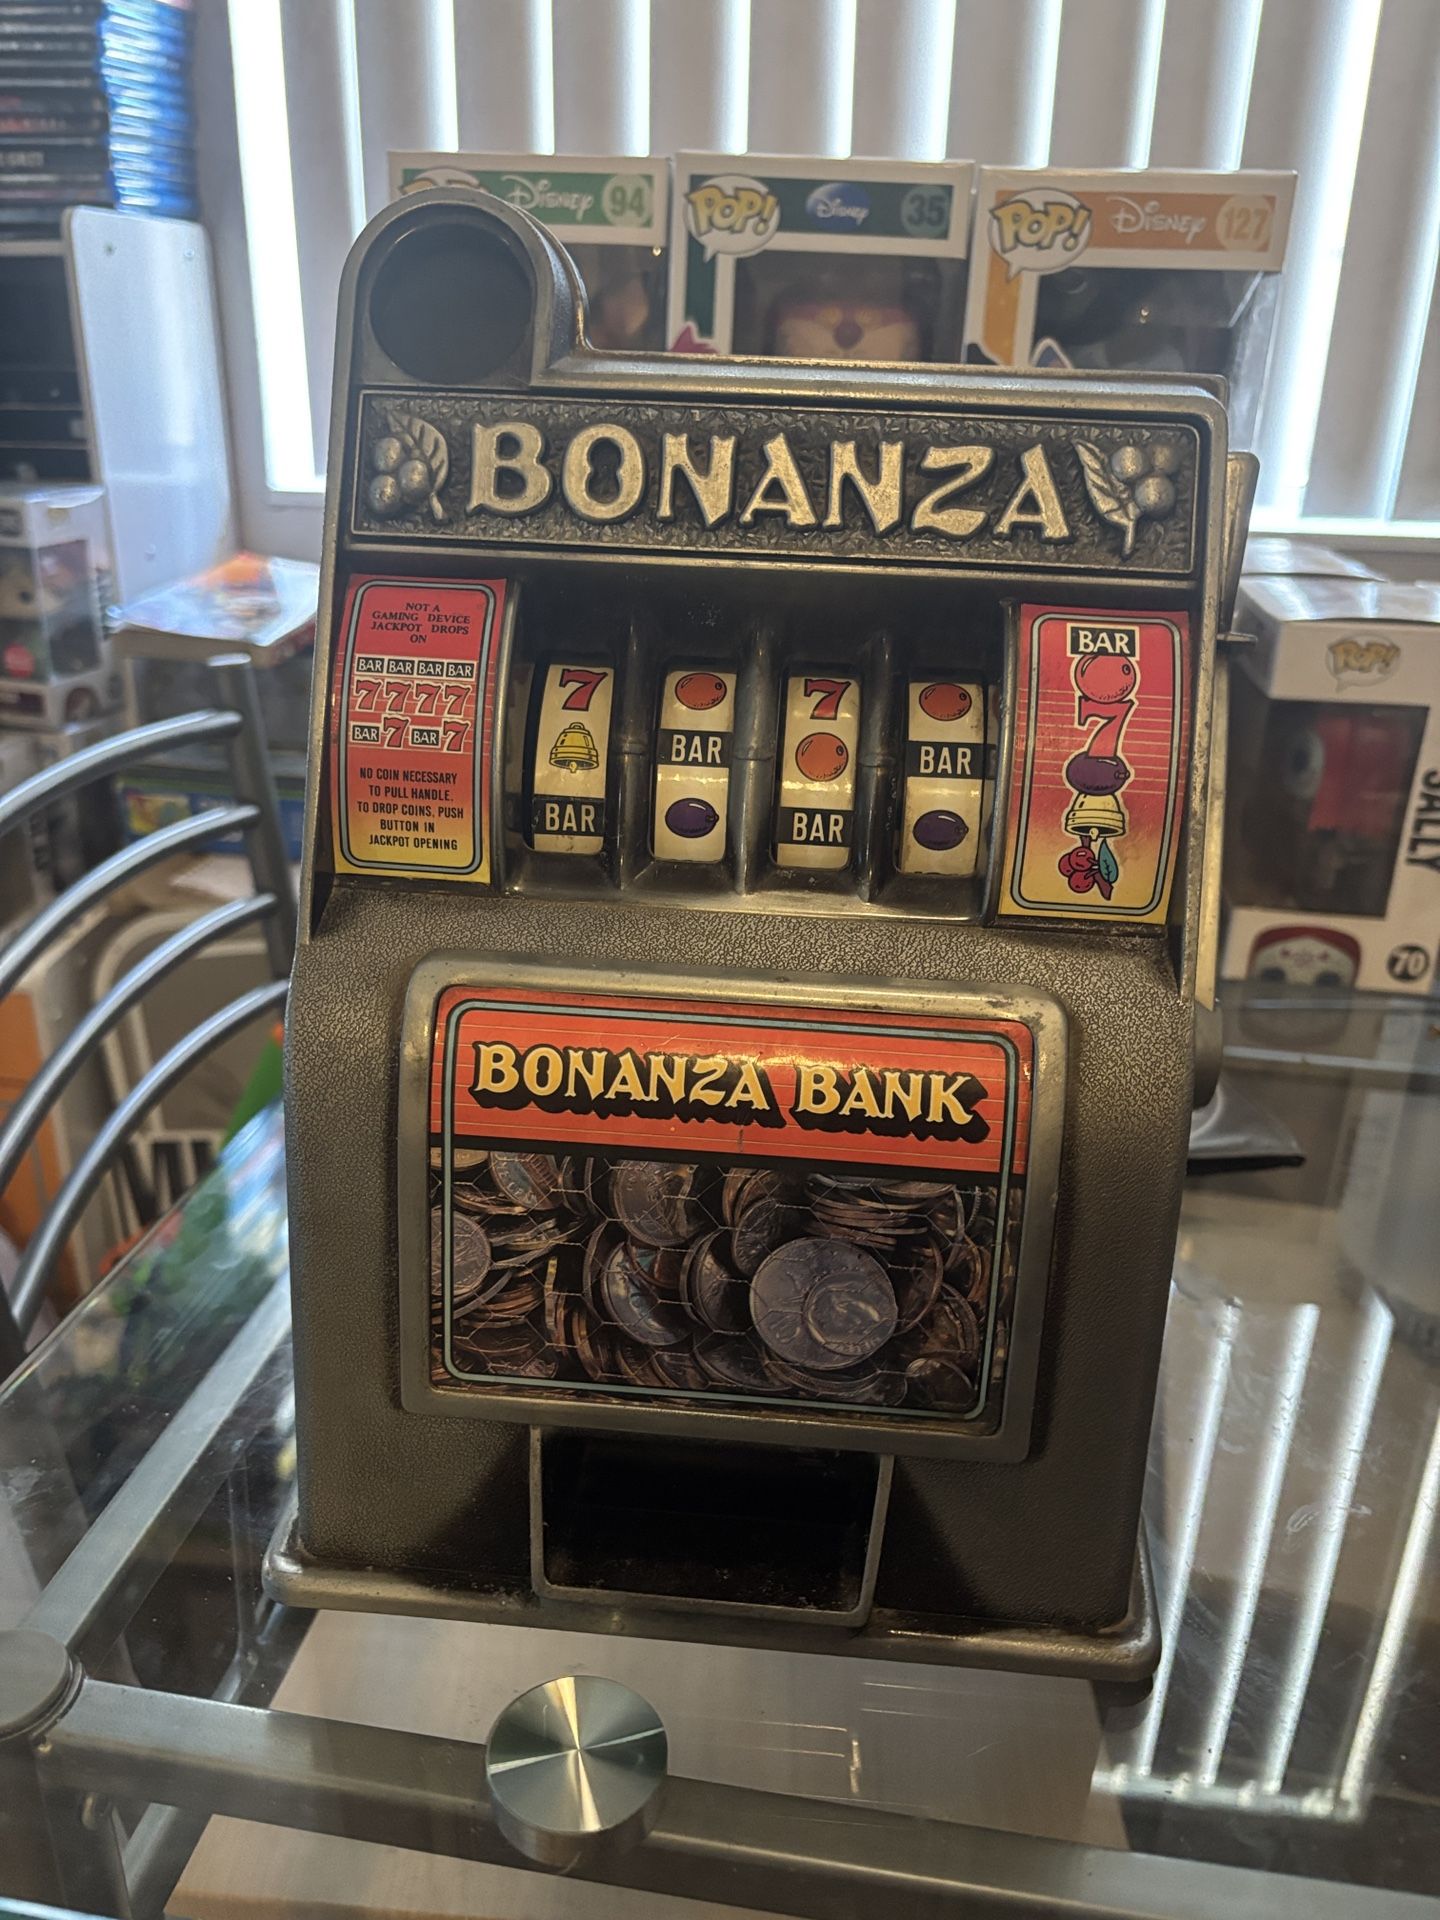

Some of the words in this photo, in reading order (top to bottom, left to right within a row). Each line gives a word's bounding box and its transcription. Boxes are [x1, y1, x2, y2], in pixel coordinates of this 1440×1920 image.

[609, 185, 645, 218] 94
[816, 197, 869, 226] Disney
[906, 193, 946, 228] 35
[1105, 196, 1206, 244] Disney
[1222, 206, 1269, 242] 127
[466, 421, 1076, 544] BONANZA
[372, 610, 419, 622] GAMING
[428, 613, 471, 624] DEVICE
[405, 602, 430, 612] NOT
[432, 604, 441, 613] A
[371, 622, 422, 633] JACKPOT
[431, 624, 469, 635] DROPS
[410, 634, 427, 644] ON
[1077, 630, 1130, 654] BAR
[358, 659, 382, 672] BAR
[388, 660, 412, 673] BAR
[418, 662, 442, 675] BAR
[447, 664, 472, 677] BAR
[559, 669, 608, 712] 7
[803, 678, 852, 720] 7
[354, 727, 378, 741] BAR
[383, 716, 410, 749] 7
[413, 731, 437, 744] BAR
[443, 720, 470, 752] 7
[1078, 696, 1136, 758] 7
[671, 734, 722, 764] BAR
[920, 745, 972, 776] BAR
[360, 767, 372, 779] NO
[376, 768, 399, 780] COIN
[403, 770, 457, 784] NECESSARY
[369, 785, 380, 796] TO
[384, 786, 408, 799] PULL
[357, 801, 369, 813] TO
[372, 802, 398, 815] DROP
[438, 806, 464, 819] PUSH
[545, 803, 595, 833] BAR
[380, 819, 419, 832] BUTTON
[424, 822, 435, 833] IN
[793, 812, 844, 843] BAR
[369, 834, 410, 847] JACKPOT
[413, 837, 457, 850] OPENING
[1390, 949, 1423, 977] 70
[474, 1042, 772, 1114] BONANZA
[794, 1065, 976, 1126] BANK
